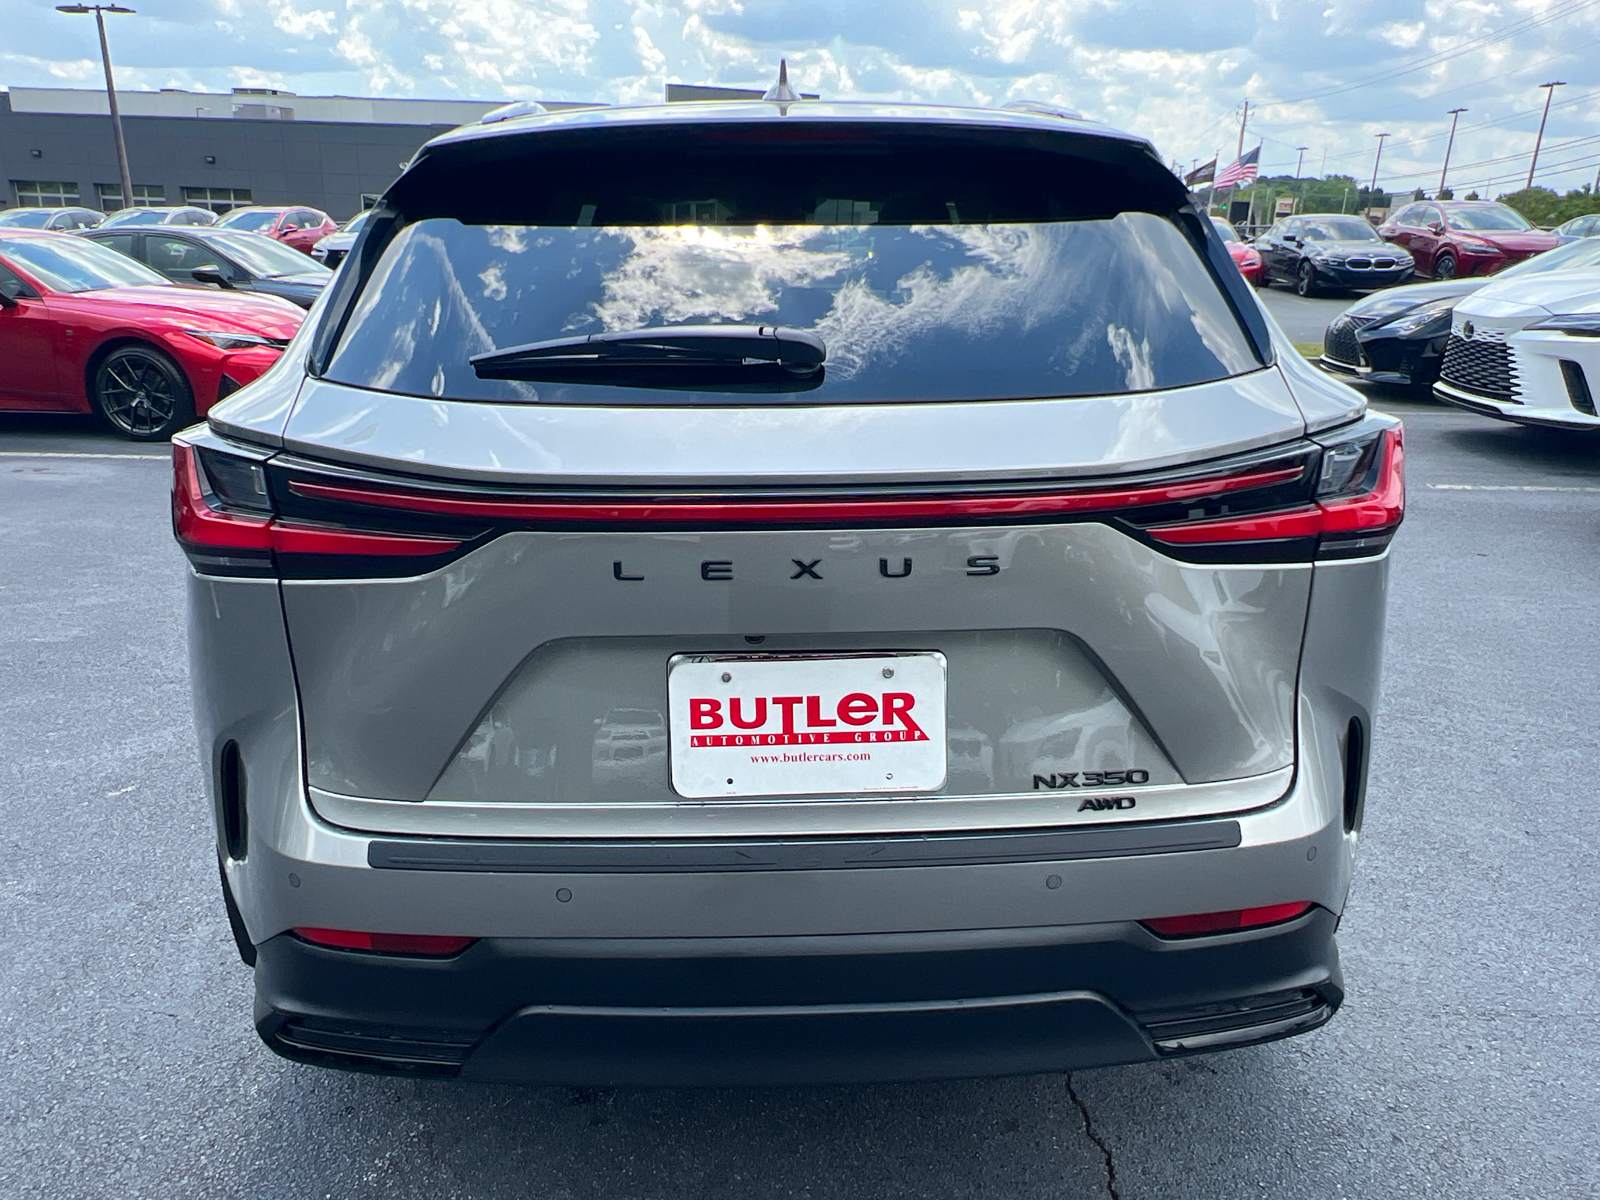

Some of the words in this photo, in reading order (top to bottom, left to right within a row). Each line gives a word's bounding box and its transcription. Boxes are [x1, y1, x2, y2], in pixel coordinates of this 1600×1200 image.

[612, 555, 1001, 581] LEXUS
[691, 733, 830, 747] AUTOMOTIVE
[854, 731, 921, 743] GROUP
[750, 752, 871, 764] www.butlercars.com
[1033, 769, 1149, 789] NX350
[1077, 797, 1136, 812] AWD
